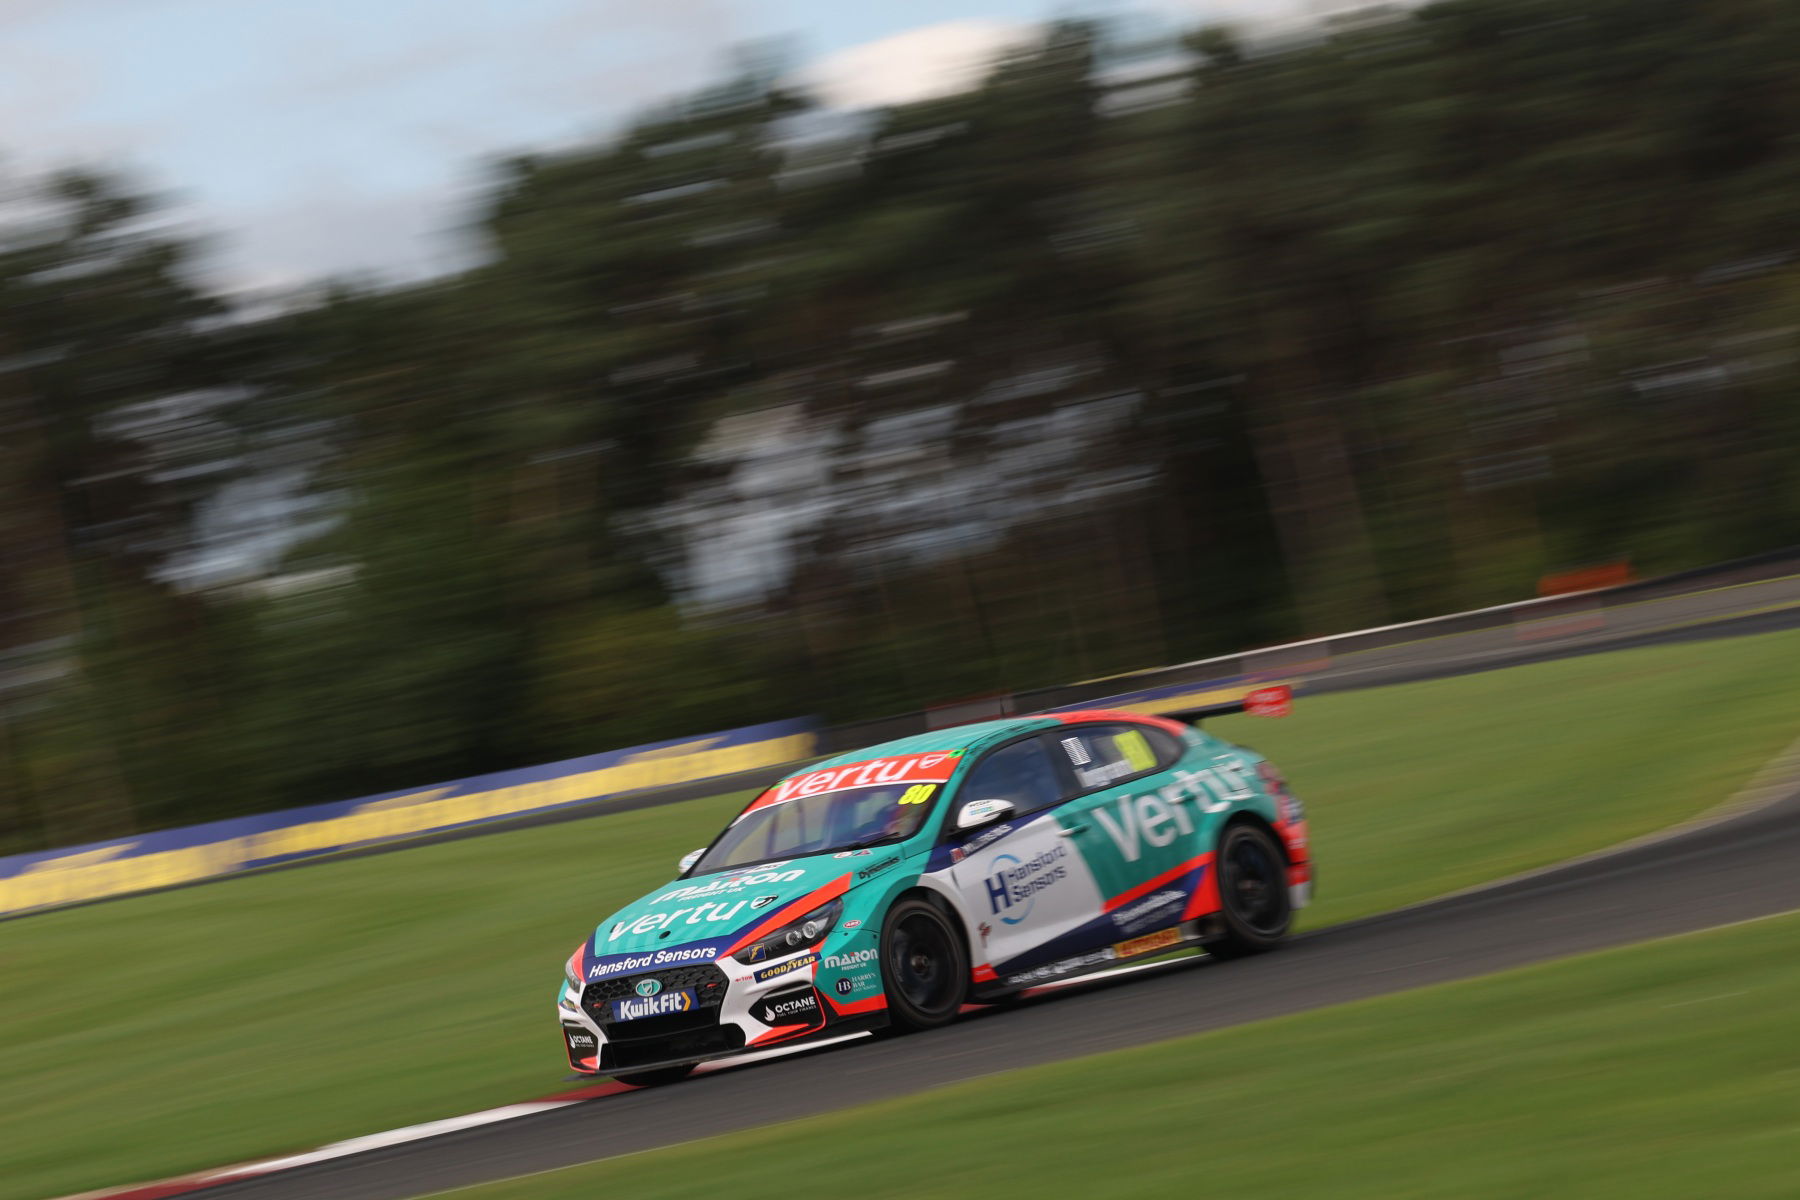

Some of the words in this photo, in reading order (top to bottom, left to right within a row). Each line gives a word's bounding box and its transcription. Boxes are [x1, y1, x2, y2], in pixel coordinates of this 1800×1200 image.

[898, 783, 937, 805] 80
[985, 871, 1013, 915] H
[589, 954, 652, 978] Hansford
[654, 947, 717, 965] Sensors
[760, 955, 816, 979] GOODYEAR
[775, 996, 815, 1012] OCTANE
